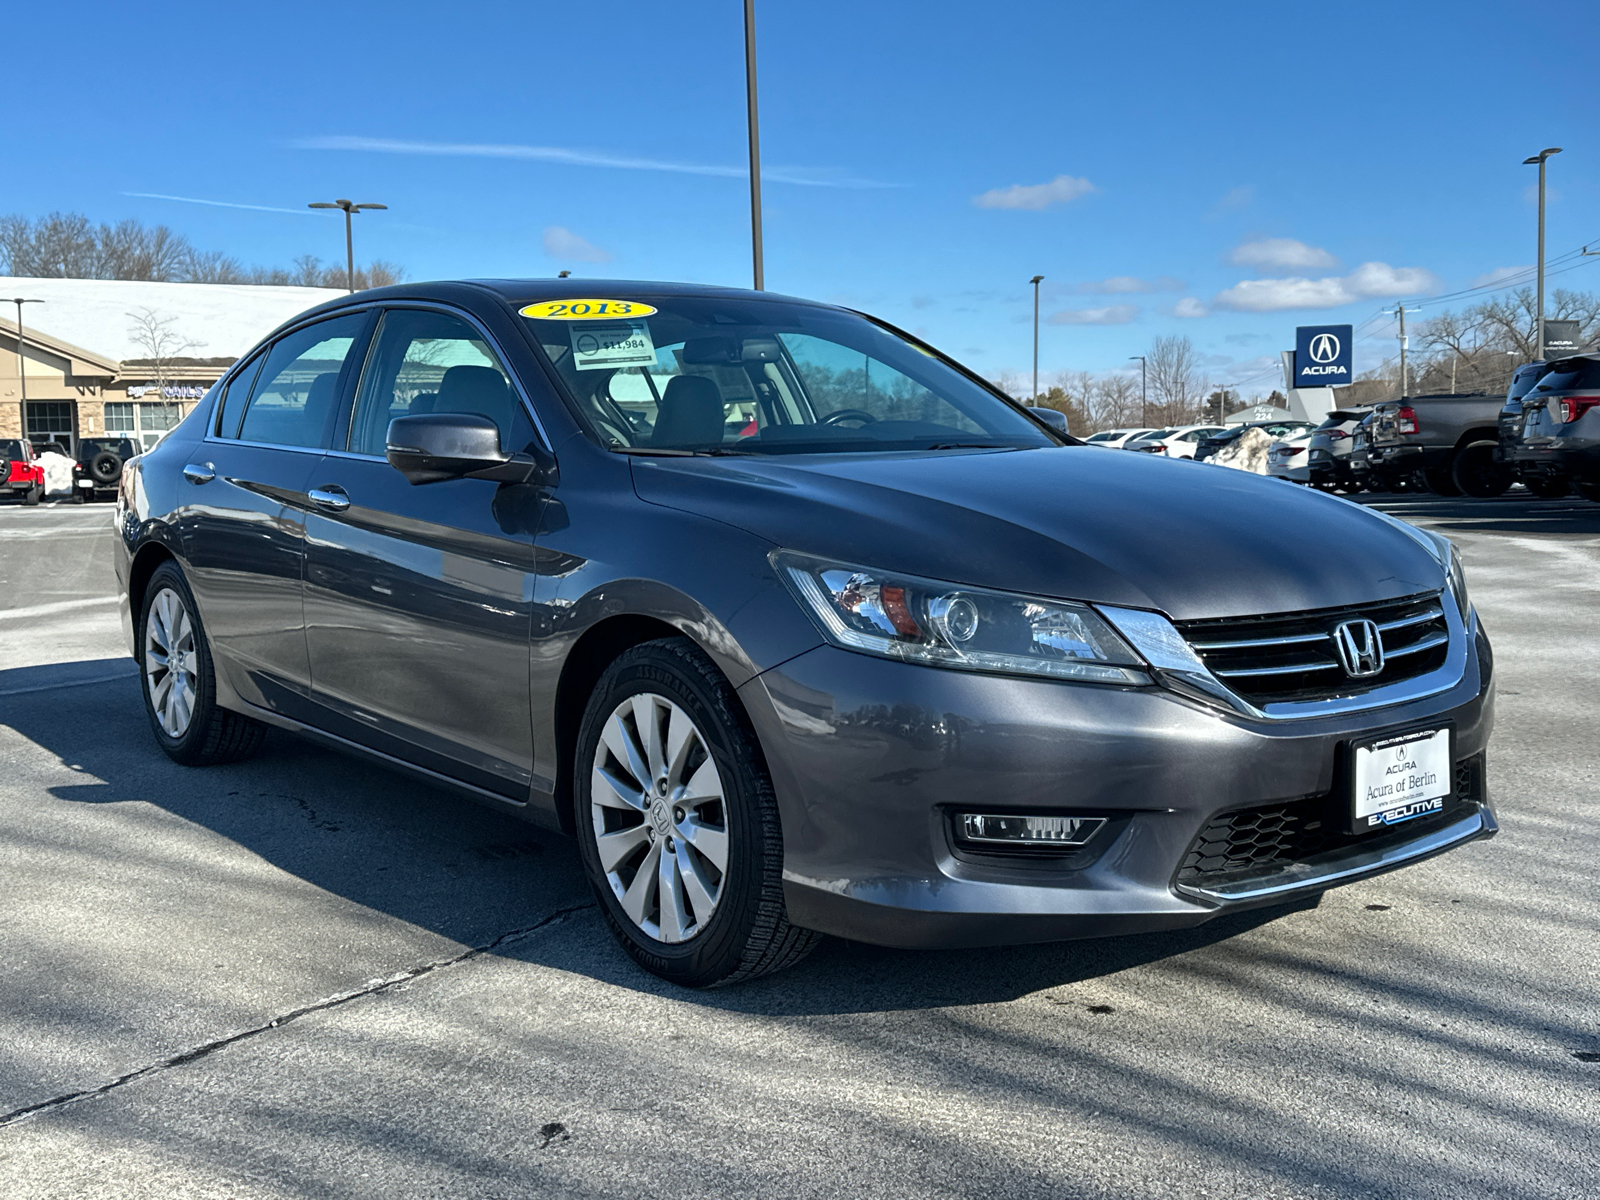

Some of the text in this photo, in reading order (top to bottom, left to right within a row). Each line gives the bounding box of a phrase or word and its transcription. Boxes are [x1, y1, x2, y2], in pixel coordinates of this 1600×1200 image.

[547, 303, 632, 316] 2013
[602, 340, 645, 351] $11,984
[1301, 366, 1347, 375] ACURA
[635, 666, 704, 711] ASSURANCE
[1385, 761, 1417, 775] ACURA
[1366, 771, 1437, 801] Acura of Berlin
[1368, 797, 1443, 826] EXECUTIVE
